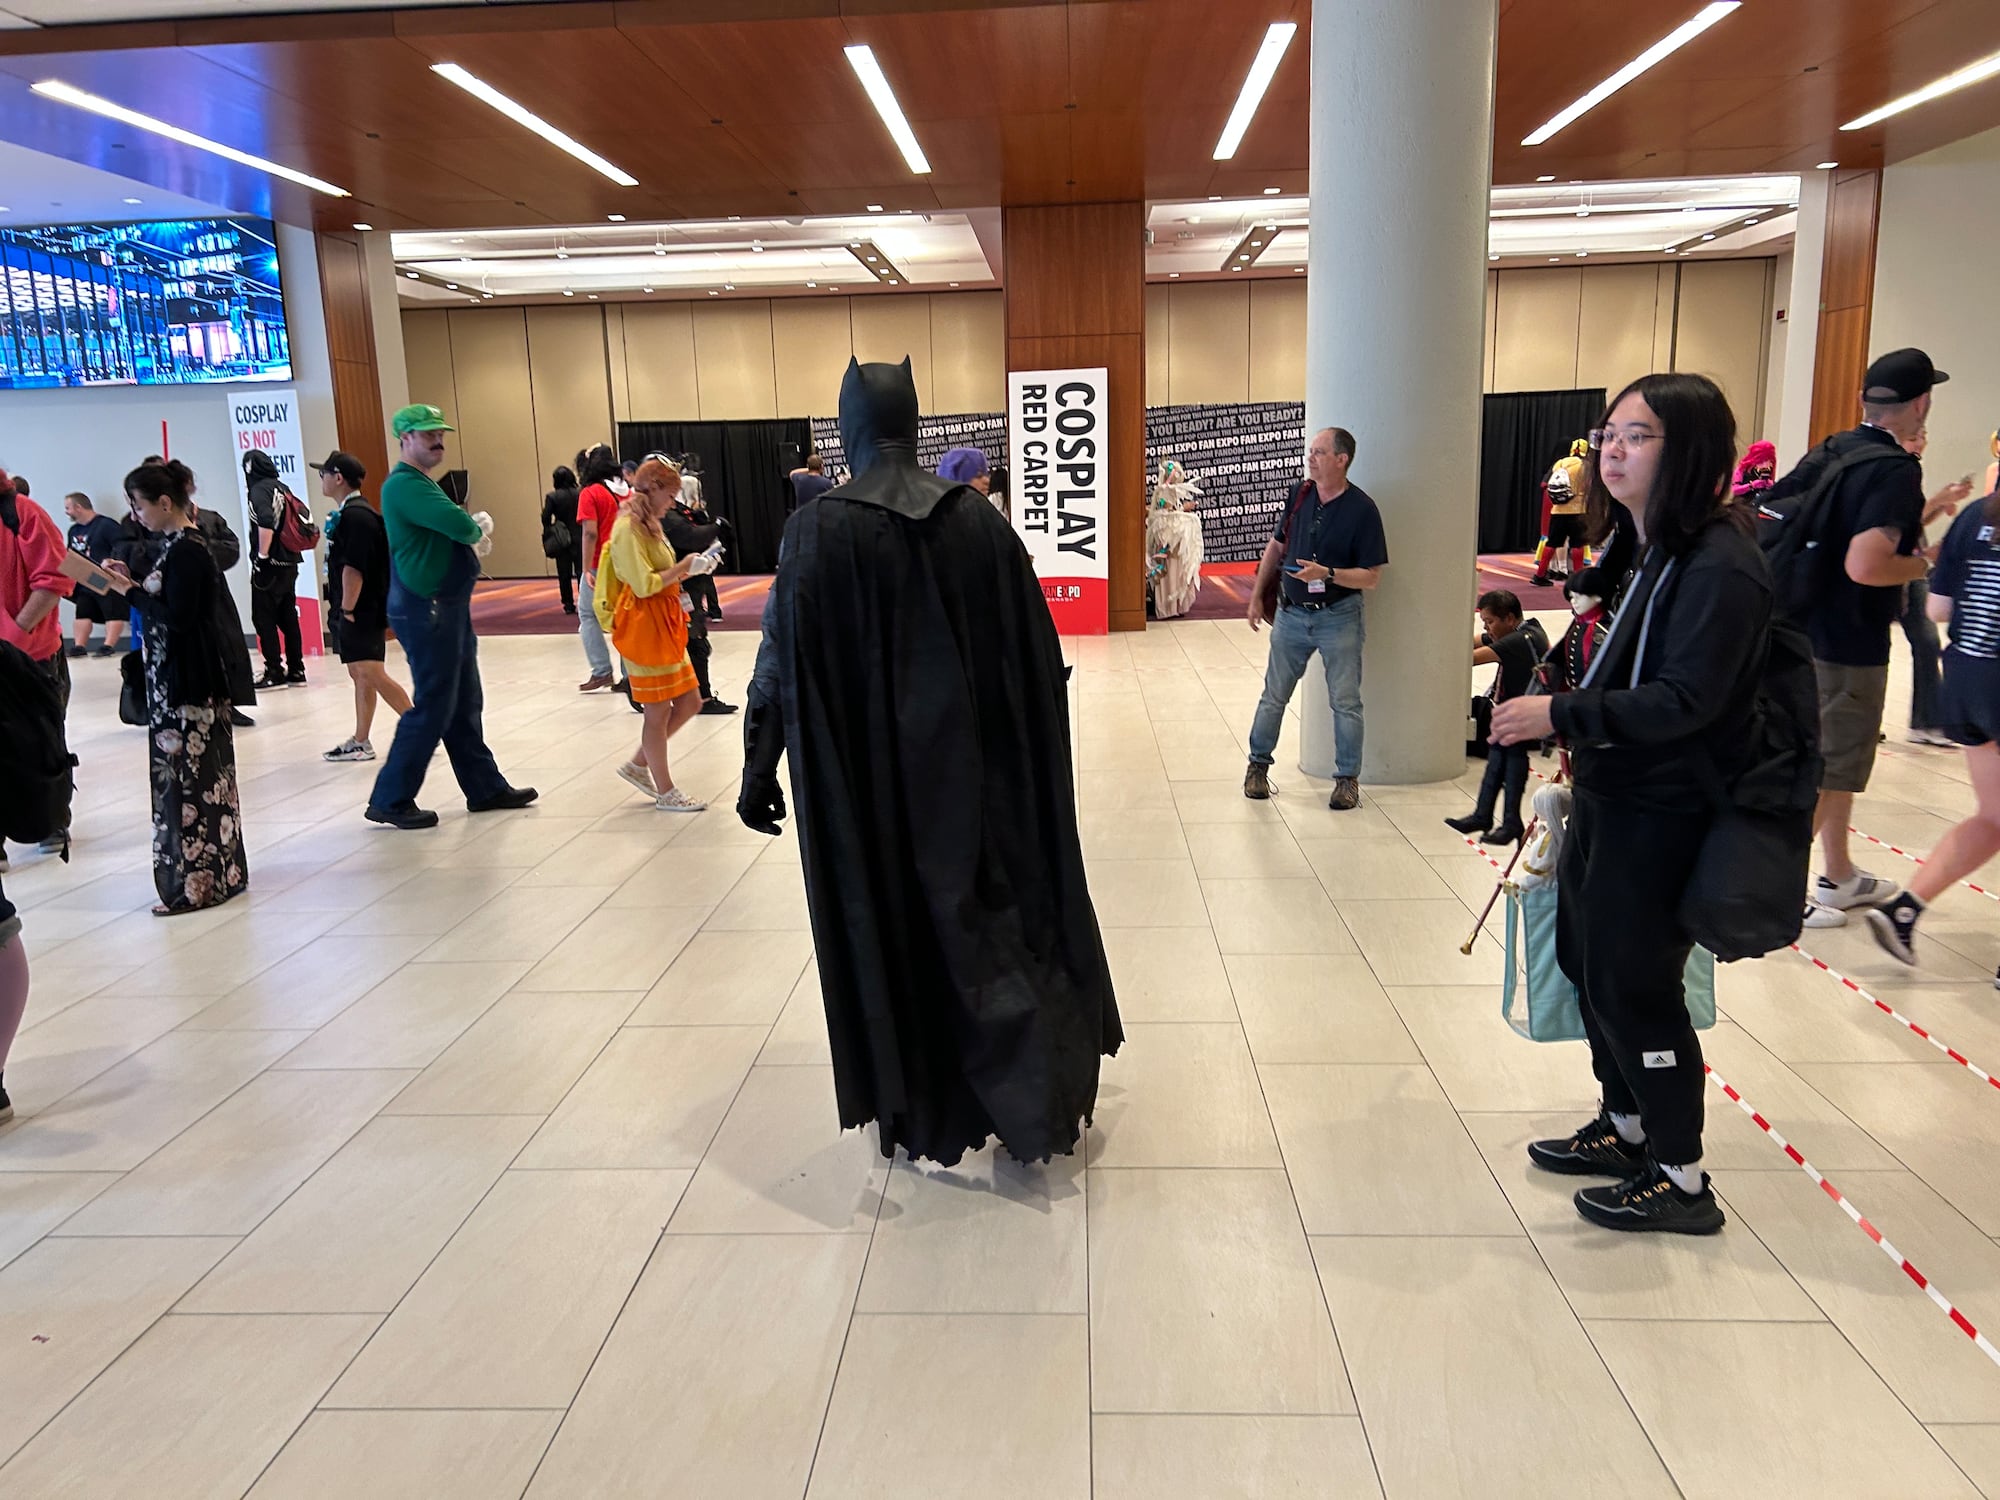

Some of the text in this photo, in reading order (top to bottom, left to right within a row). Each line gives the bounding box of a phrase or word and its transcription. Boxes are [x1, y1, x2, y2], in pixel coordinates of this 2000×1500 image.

[236, 403, 288, 424] COSPLAY
[1151, 423, 1173, 437] YOU
[1175, 418, 1214, 435] READY?
[1216, 415, 1237, 429] ARE
[1238, 412, 1260, 426] YOU
[1262, 407, 1303, 423] READY?
[922, 426, 944, 438] EXPO
[945, 424, 962, 435] FAN
[963, 421, 986, 432] EXPO
[986, 418, 1004, 429] FAN
[239, 430, 276, 449] IS NOT
[824, 438, 840, 449] FAN
[1157, 444, 1174, 456] FAN
[1174, 441, 1198, 453] EXPO
[1198, 438, 1215, 450] FAN
[1216, 436, 1239, 448] EXPO
[1240, 433, 1257, 445] FAN
[1258, 431, 1282, 443] EXPO
[1282, 428, 1300, 440] FAN
[1022, 384, 1048, 534] RED CARPET
[1184, 450, 1213, 461] FANDOM
[1214, 446, 1244, 457] FANDOM
[1245, 442, 1276, 454] FANDOM
[269, 454, 295, 473] ENT
[1055, 382, 1096, 560] COSPLAY
[1200, 466, 1217, 477] FAN
[1217, 463, 1241, 475] EXPO
[1241, 461, 1259, 473] FAN
[1260, 458, 1283, 470] EXPO
[1284, 456, 1301, 467] FAN
[1212, 476, 1228, 486] THE
[1228, 474, 1250, 485] WAIT
[1251, 472, 1260, 482] IS
[1261, 468, 1295, 481] FINALLY
[1219, 493, 1240, 506] FOR
[1241, 491, 1261, 504] THE
[1263, 487, 1290, 501] FANS
[1203, 509, 1219, 519] FAN
[1220, 506, 1243, 517] EXPO
[1244, 504, 1261, 514] FAN
[1262, 501, 1285, 512] EXPO
[1205, 520, 1221, 530] ARE
[1222, 517, 1240, 528] YOU
[1241, 512, 1274, 525] READY?
[1228, 534, 1244, 545] FAN
[1210, 553, 1233, 562] NEXT
[1234, 551, 1258, 560] LEVEL
